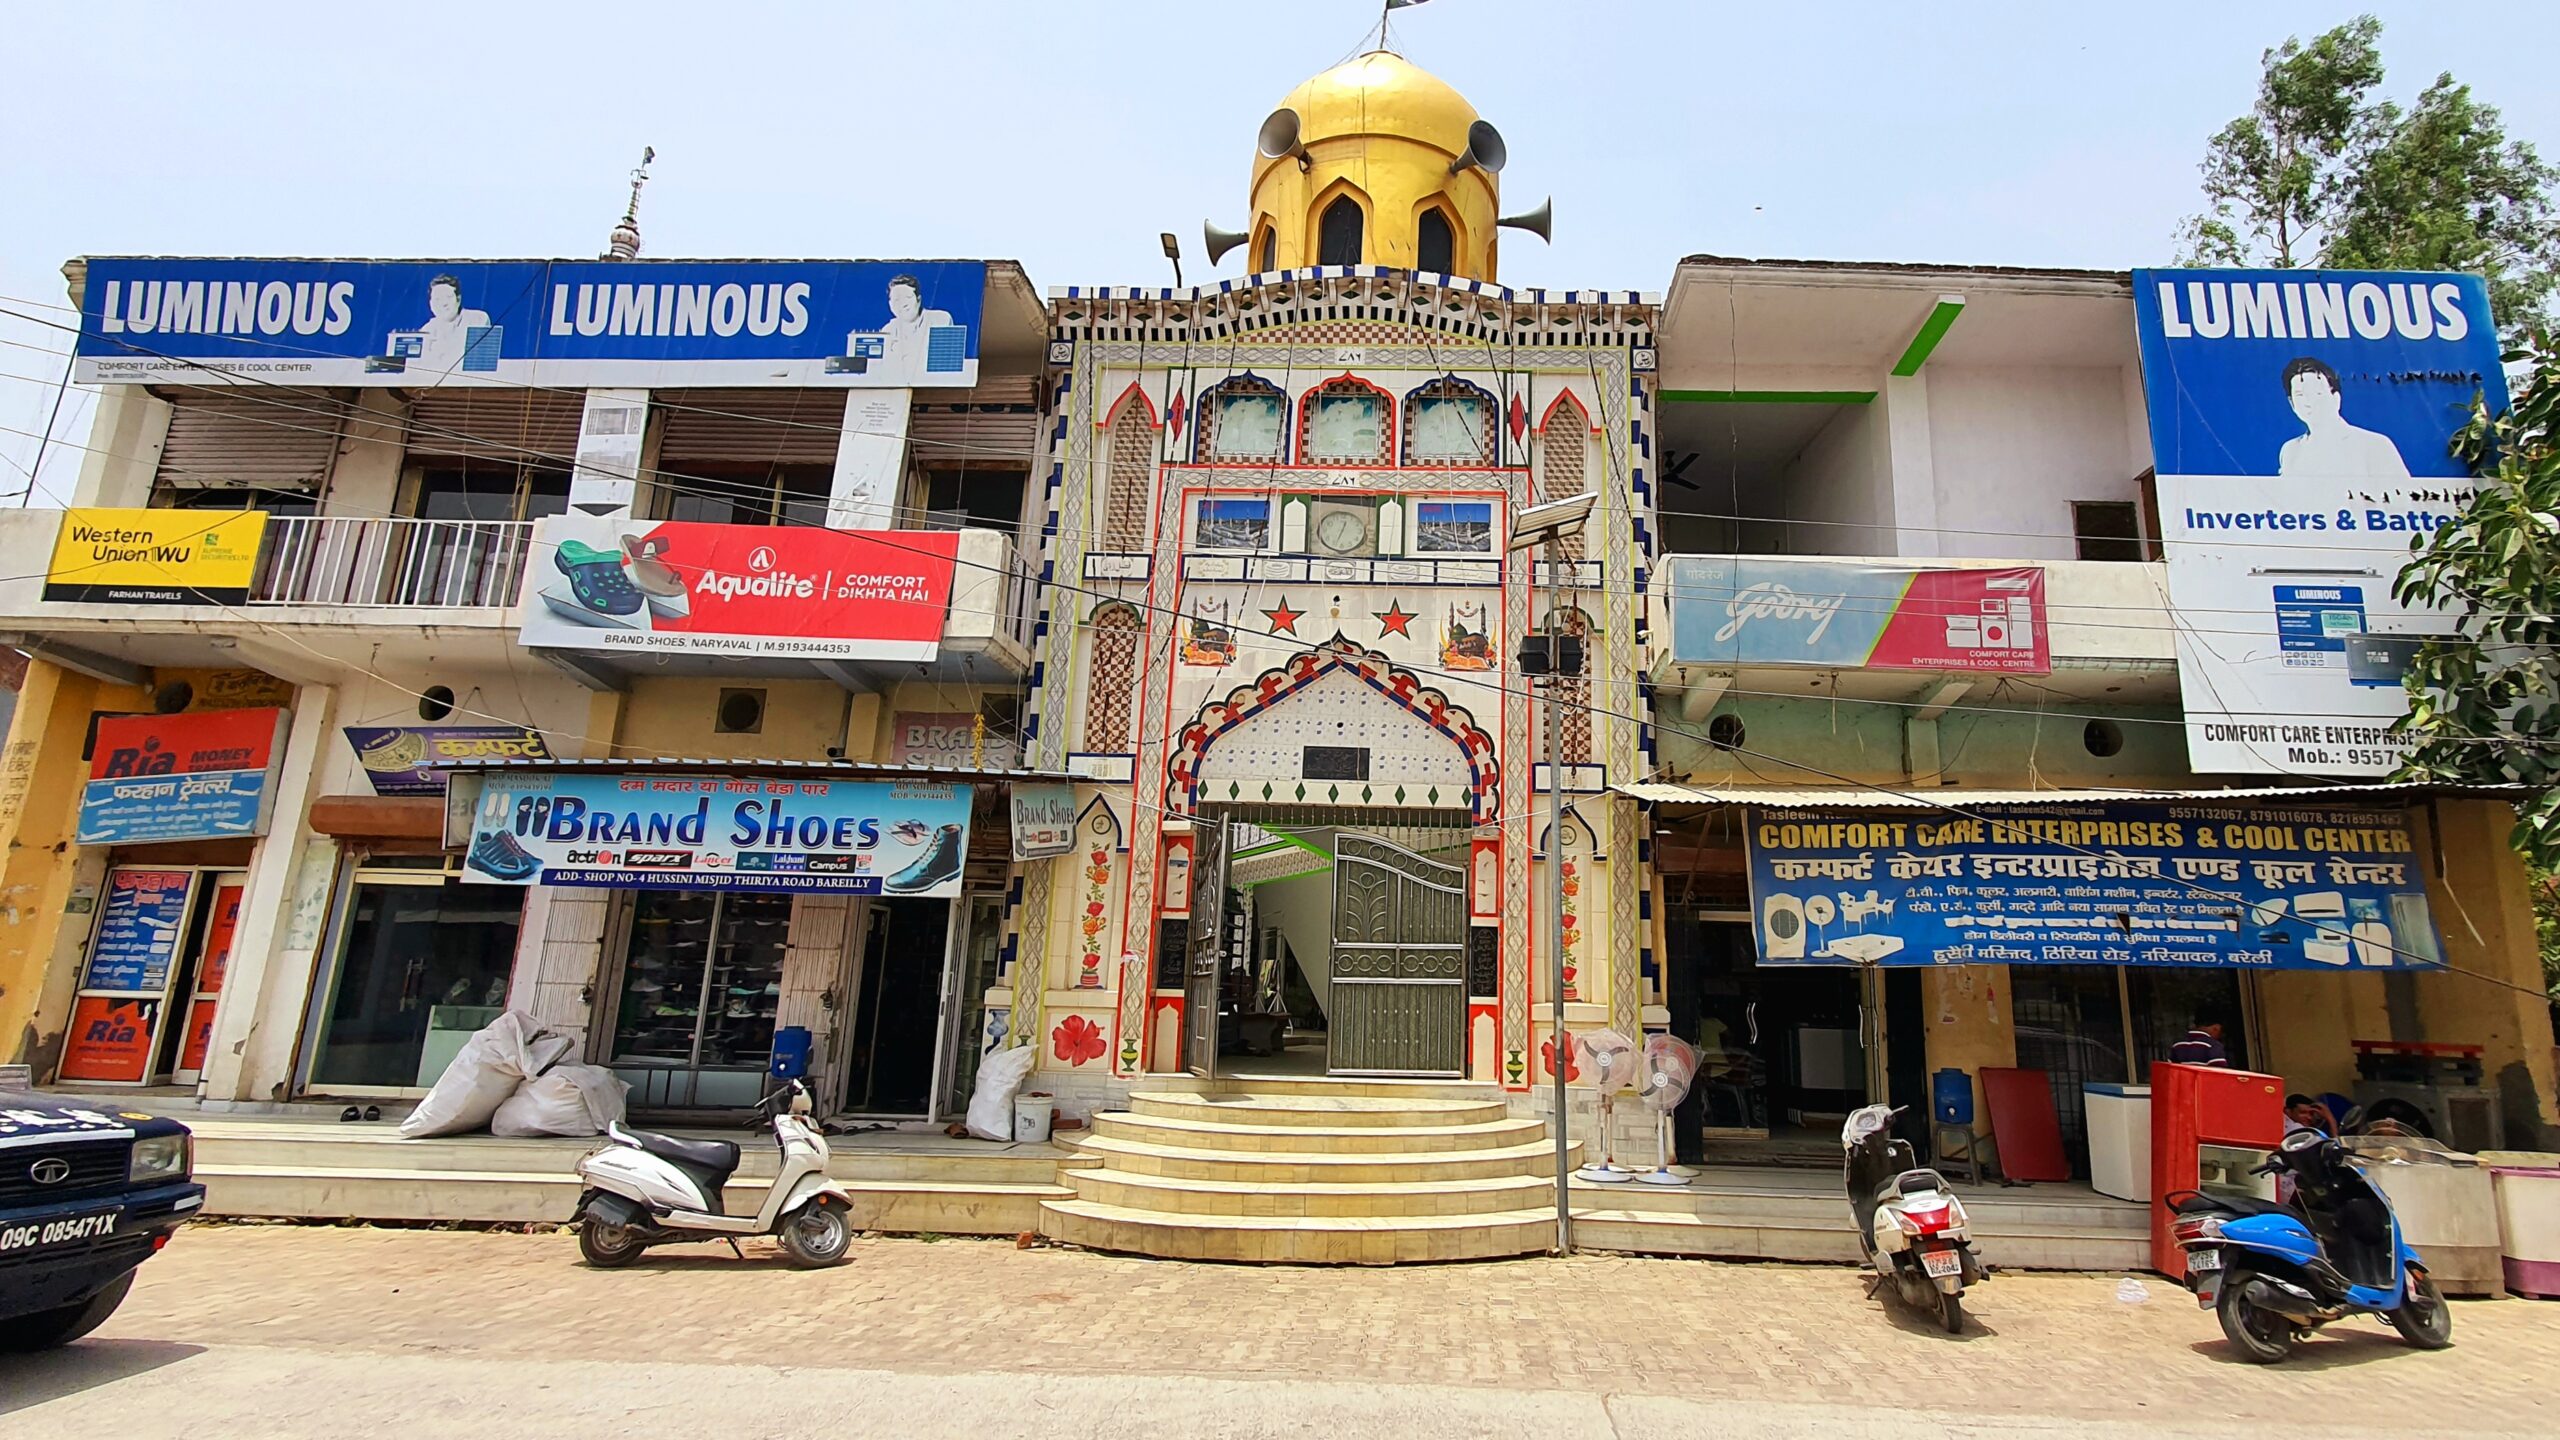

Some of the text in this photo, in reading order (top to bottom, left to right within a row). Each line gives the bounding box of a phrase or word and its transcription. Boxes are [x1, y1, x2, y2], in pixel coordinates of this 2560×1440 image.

[102, 280, 354, 337] LUMINOUS
[549, 283, 811, 337] LUMINOUS
[2158, 281, 2468, 342] LUMINOUS
[146, 363, 171, 371] CARE
[2186, 508, 2327, 531] Inverters
[2336, 509, 2357, 531] &
[72, 526, 153, 544] Western
[92, 545, 190, 563] Union WU
[695, 569, 814, 603] Aqualite
[846, 574, 926, 588] COMFORT
[108, 590, 182, 600] FARHAN TRAVELS
[837, 587, 929, 602] DIKHTA HAI
[2294, 590, 2342, 600] LUMINOUS
[1715, 582, 1847, 645] Godrej
[604, 634, 644, 645] BRAND
[691, 639, 752, 650] NARYAVAL
[764, 642, 851, 654] M.9193444353
[1912, 658, 1968, 666] ENTERPRISES
[2002, 660, 2035, 668] CENTRE
[1969, 650, 2034, 659] COMFORT CARE
[2204, 724, 2276, 742] COMFORT
[2281, 726, 2321, 743] CARE
[102, 736, 177, 779] Ria
[2288, 748, 2341, 765] Mob.:
[114, 782, 177, 800] फरहान
[620, 780, 646, 792] दम
[652, 780, 694, 793] मदार
[699, 781, 719, 793] या
[801, 783, 830, 797] पार
[2169, 807, 2248, 821] 9557132067,
[1759, 819, 2412, 853] COMFORT CARE ENTERPRISES & COOL CENTER
[809, 860, 848, 871] Campus
[1770, 852, 1875, 881] कम्फर्ट
[1885, 852, 1964, 880] केयर
[2171, 857, 2241, 882] एण्ड
[2249, 860, 2316, 890] कूल
[2325, 856, 2407, 885] सेन्टर
[554, 871, 870, 888] ADD- SHOP NO- 4 HUSSINI MISJID THIRIYA ROAD BAREILLY
[2228, 948, 2273, 965] बरेली
[85, 1014, 137, 1043] Ria
[41, 1213, 118, 1245] 085471X
